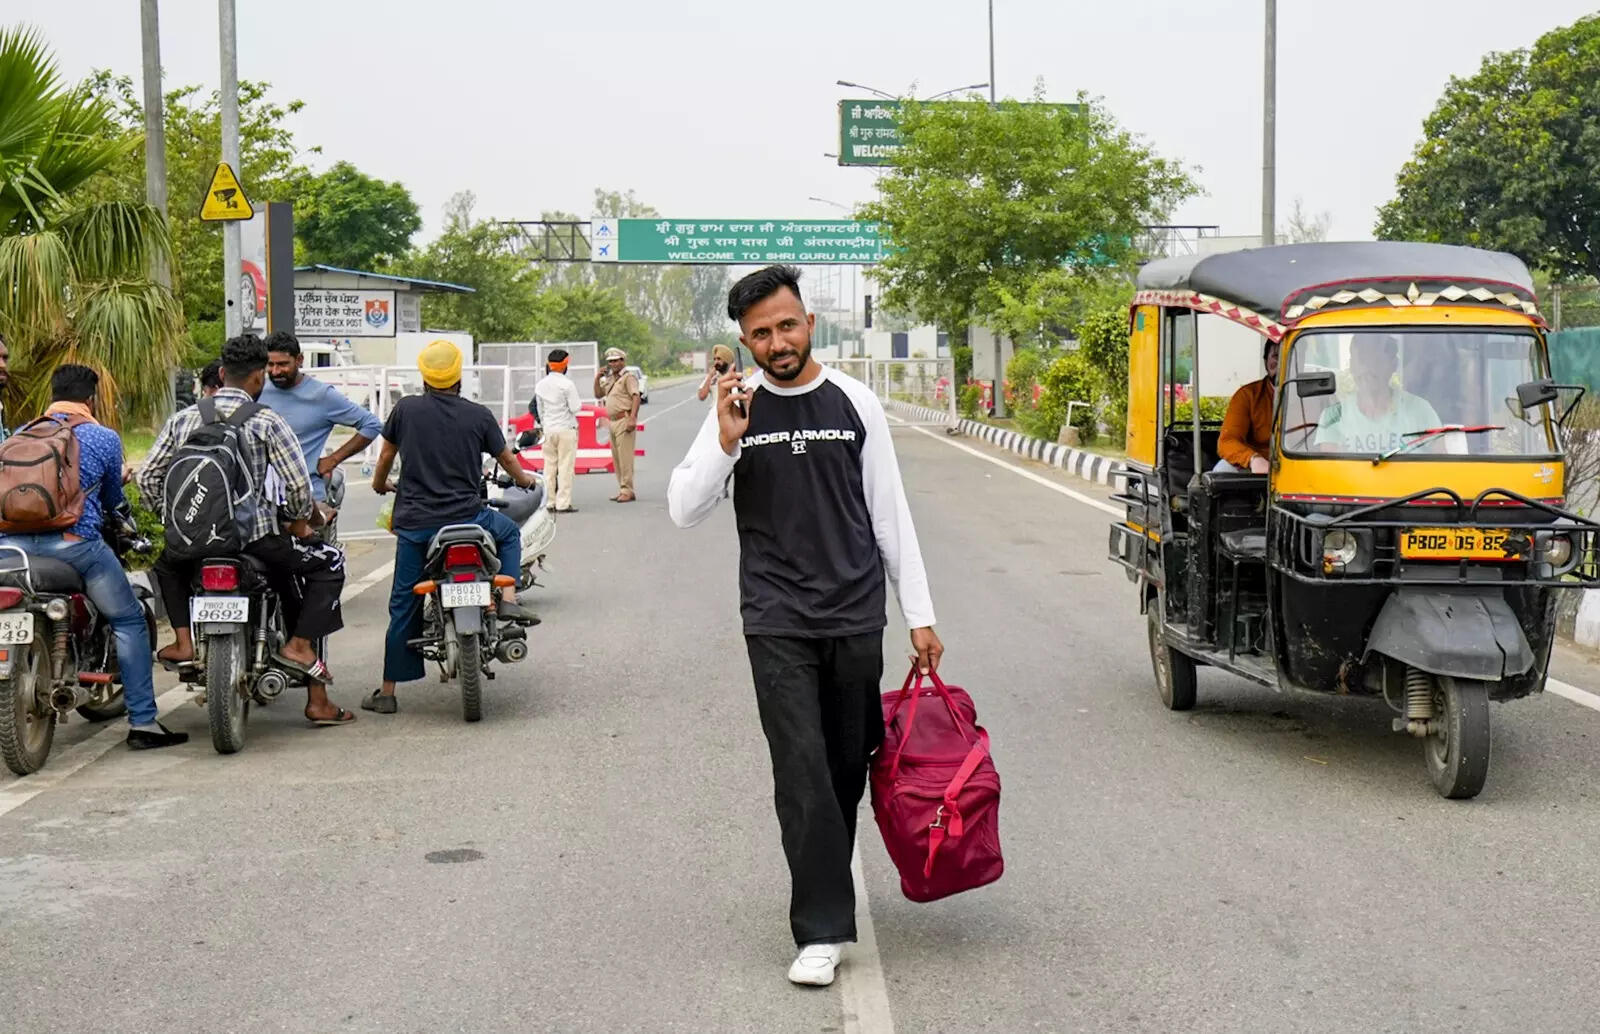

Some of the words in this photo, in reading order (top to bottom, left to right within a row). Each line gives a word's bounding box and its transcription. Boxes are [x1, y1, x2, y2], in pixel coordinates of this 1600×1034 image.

[849, 125, 859, 138] श्री
[852, 145, 899, 158] WELCOME
[664, 235, 680, 247] श्री
[714, 238, 738, 247] राम
[741, 238, 768, 247] दास
[776, 235, 793, 247] जी
[668, 252, 735, 260] WELCOME
[741, 252, 761, 260] TO
[765, 252, 796, 260] SHRI
[799, 252, 836, 260] GURU
[839, 252, 870, 260] RAM
[301, 318, 321, 327] POLICE
[324, 318, 344, 327] CHECK
[346, 318, 362, 327] POST
[739, 431, 790, 448] UNDER
[791, 429, 856, 441] ARMOUR
[185, 483, 208, 523] safari
[1483, 535, 1505, 551] 85
[197, 609, 244, 621] 9692
